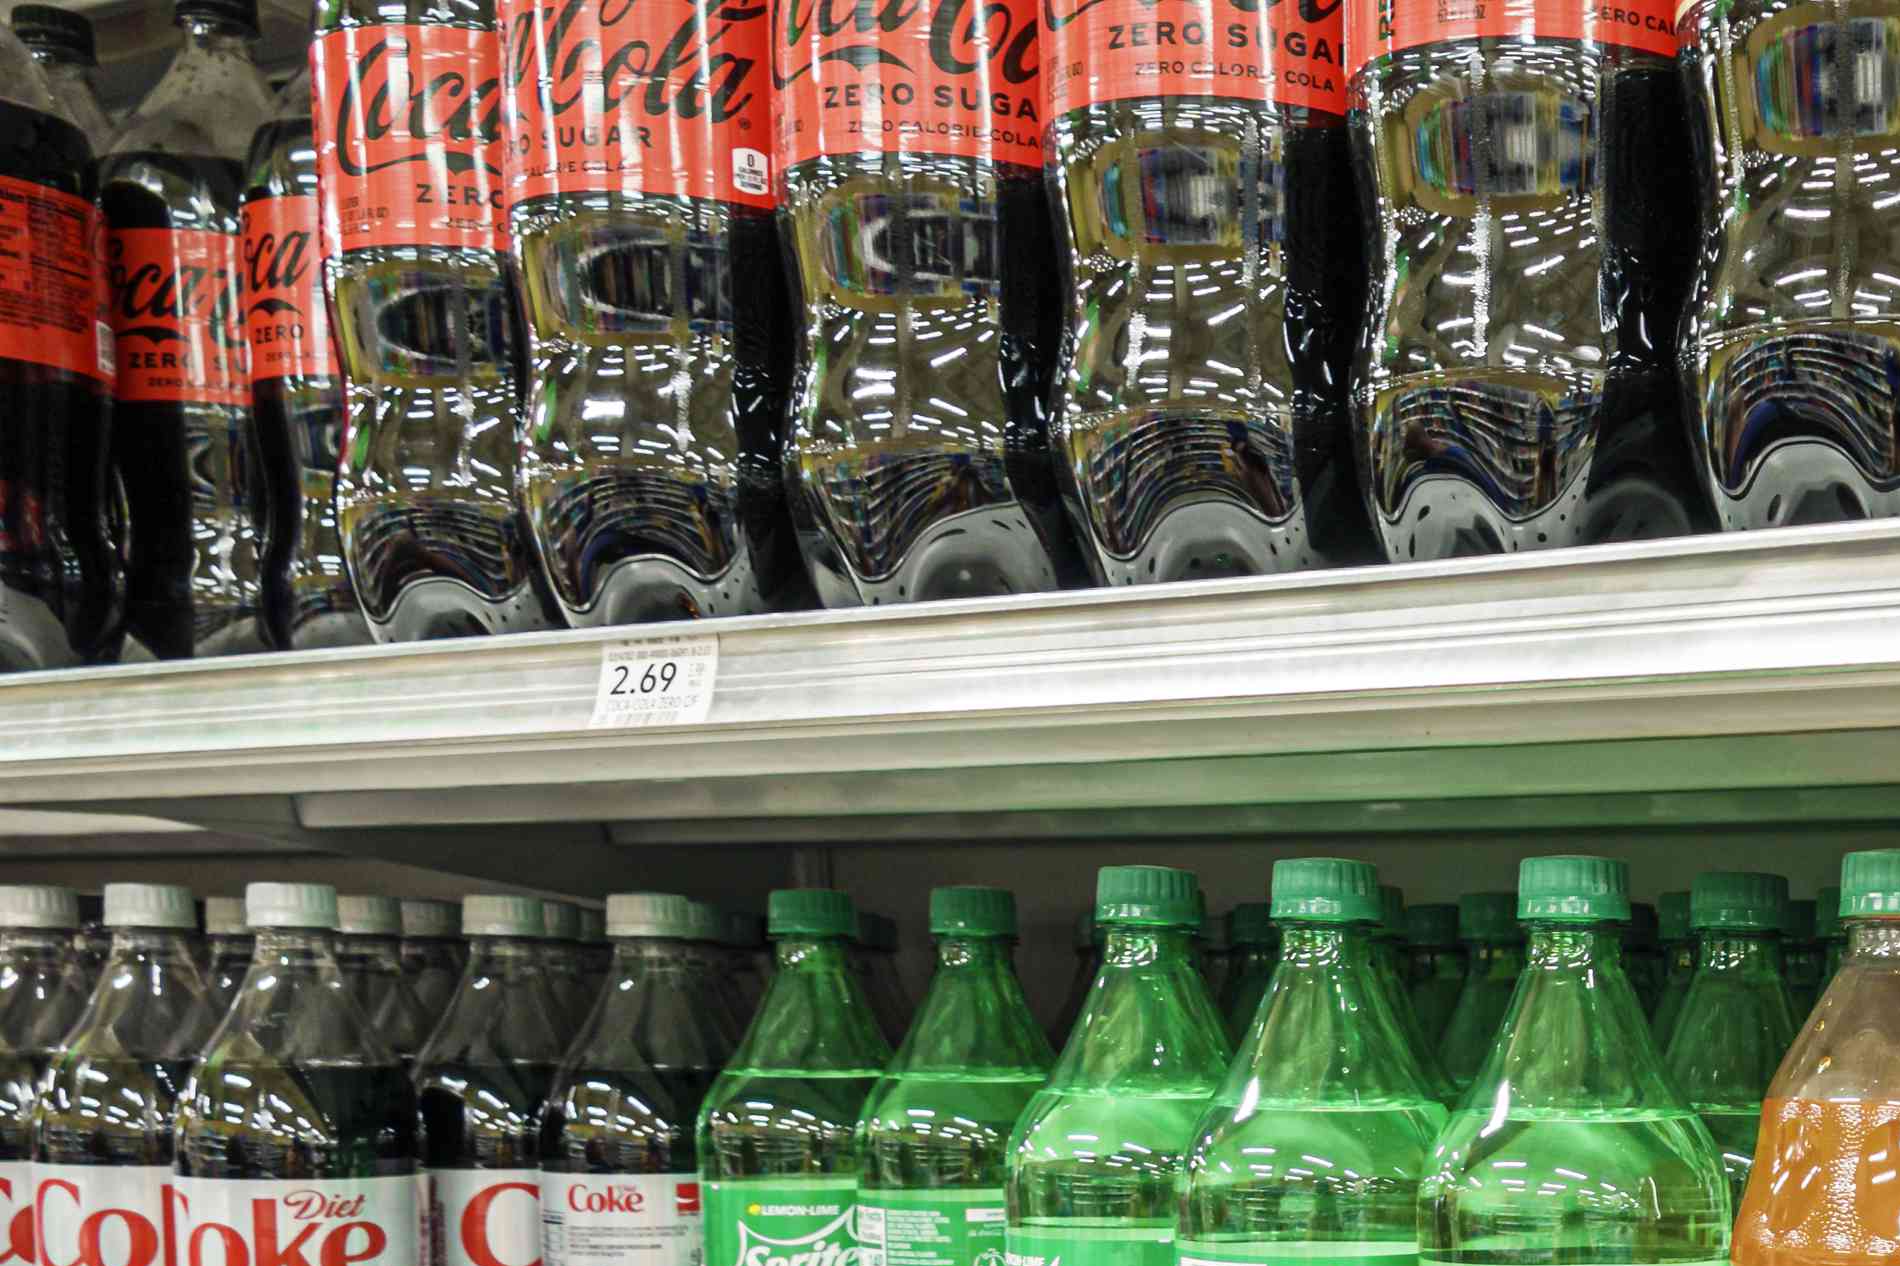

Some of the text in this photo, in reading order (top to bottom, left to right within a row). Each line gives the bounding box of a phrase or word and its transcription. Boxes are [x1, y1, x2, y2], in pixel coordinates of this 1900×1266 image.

[1108, 21, 1205, 49] ZERO
[1284, 71, 1335, 92] COLA
[823, 82, 1038, 122] ZERO SUGA
[542, 126, 652, 148] SUGAR
[989, 130, 1039, 150] COLA
[255, 324, 304, 345] ZERO
[610, 662, 677, 695] 2.69
[284, 1190, 366, 1221] Diet
[568, 1183, 644, 1213] Coke
[762, 1204, 841, 1215] LEMON-LIME
